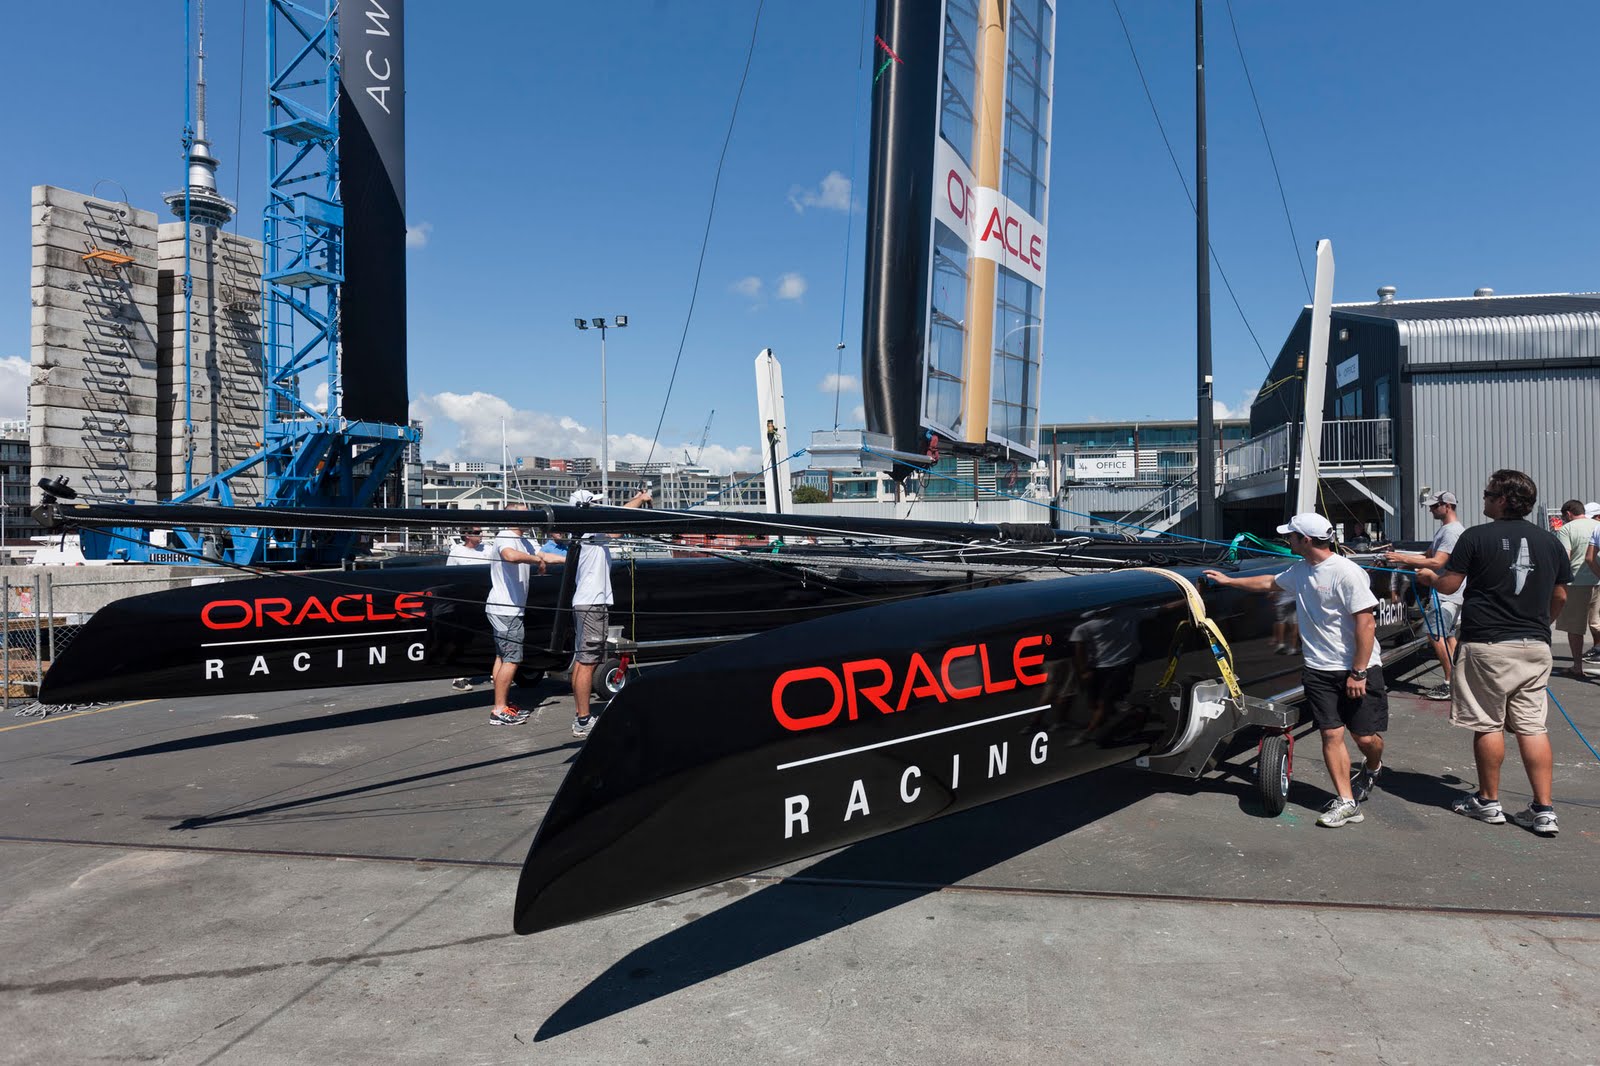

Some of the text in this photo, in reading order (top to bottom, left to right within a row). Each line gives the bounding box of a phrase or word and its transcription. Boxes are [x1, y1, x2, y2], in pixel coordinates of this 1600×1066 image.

[365, 49, 391, 115] AC
[194, 229, 202, 238] 3
[1096, 461, 1127, 470] OFFICE
[149, 553, 191, 563] LIEBHERR
[205, 643, 425, 680] RACING
[784, 732, 1049, 839] RACING
